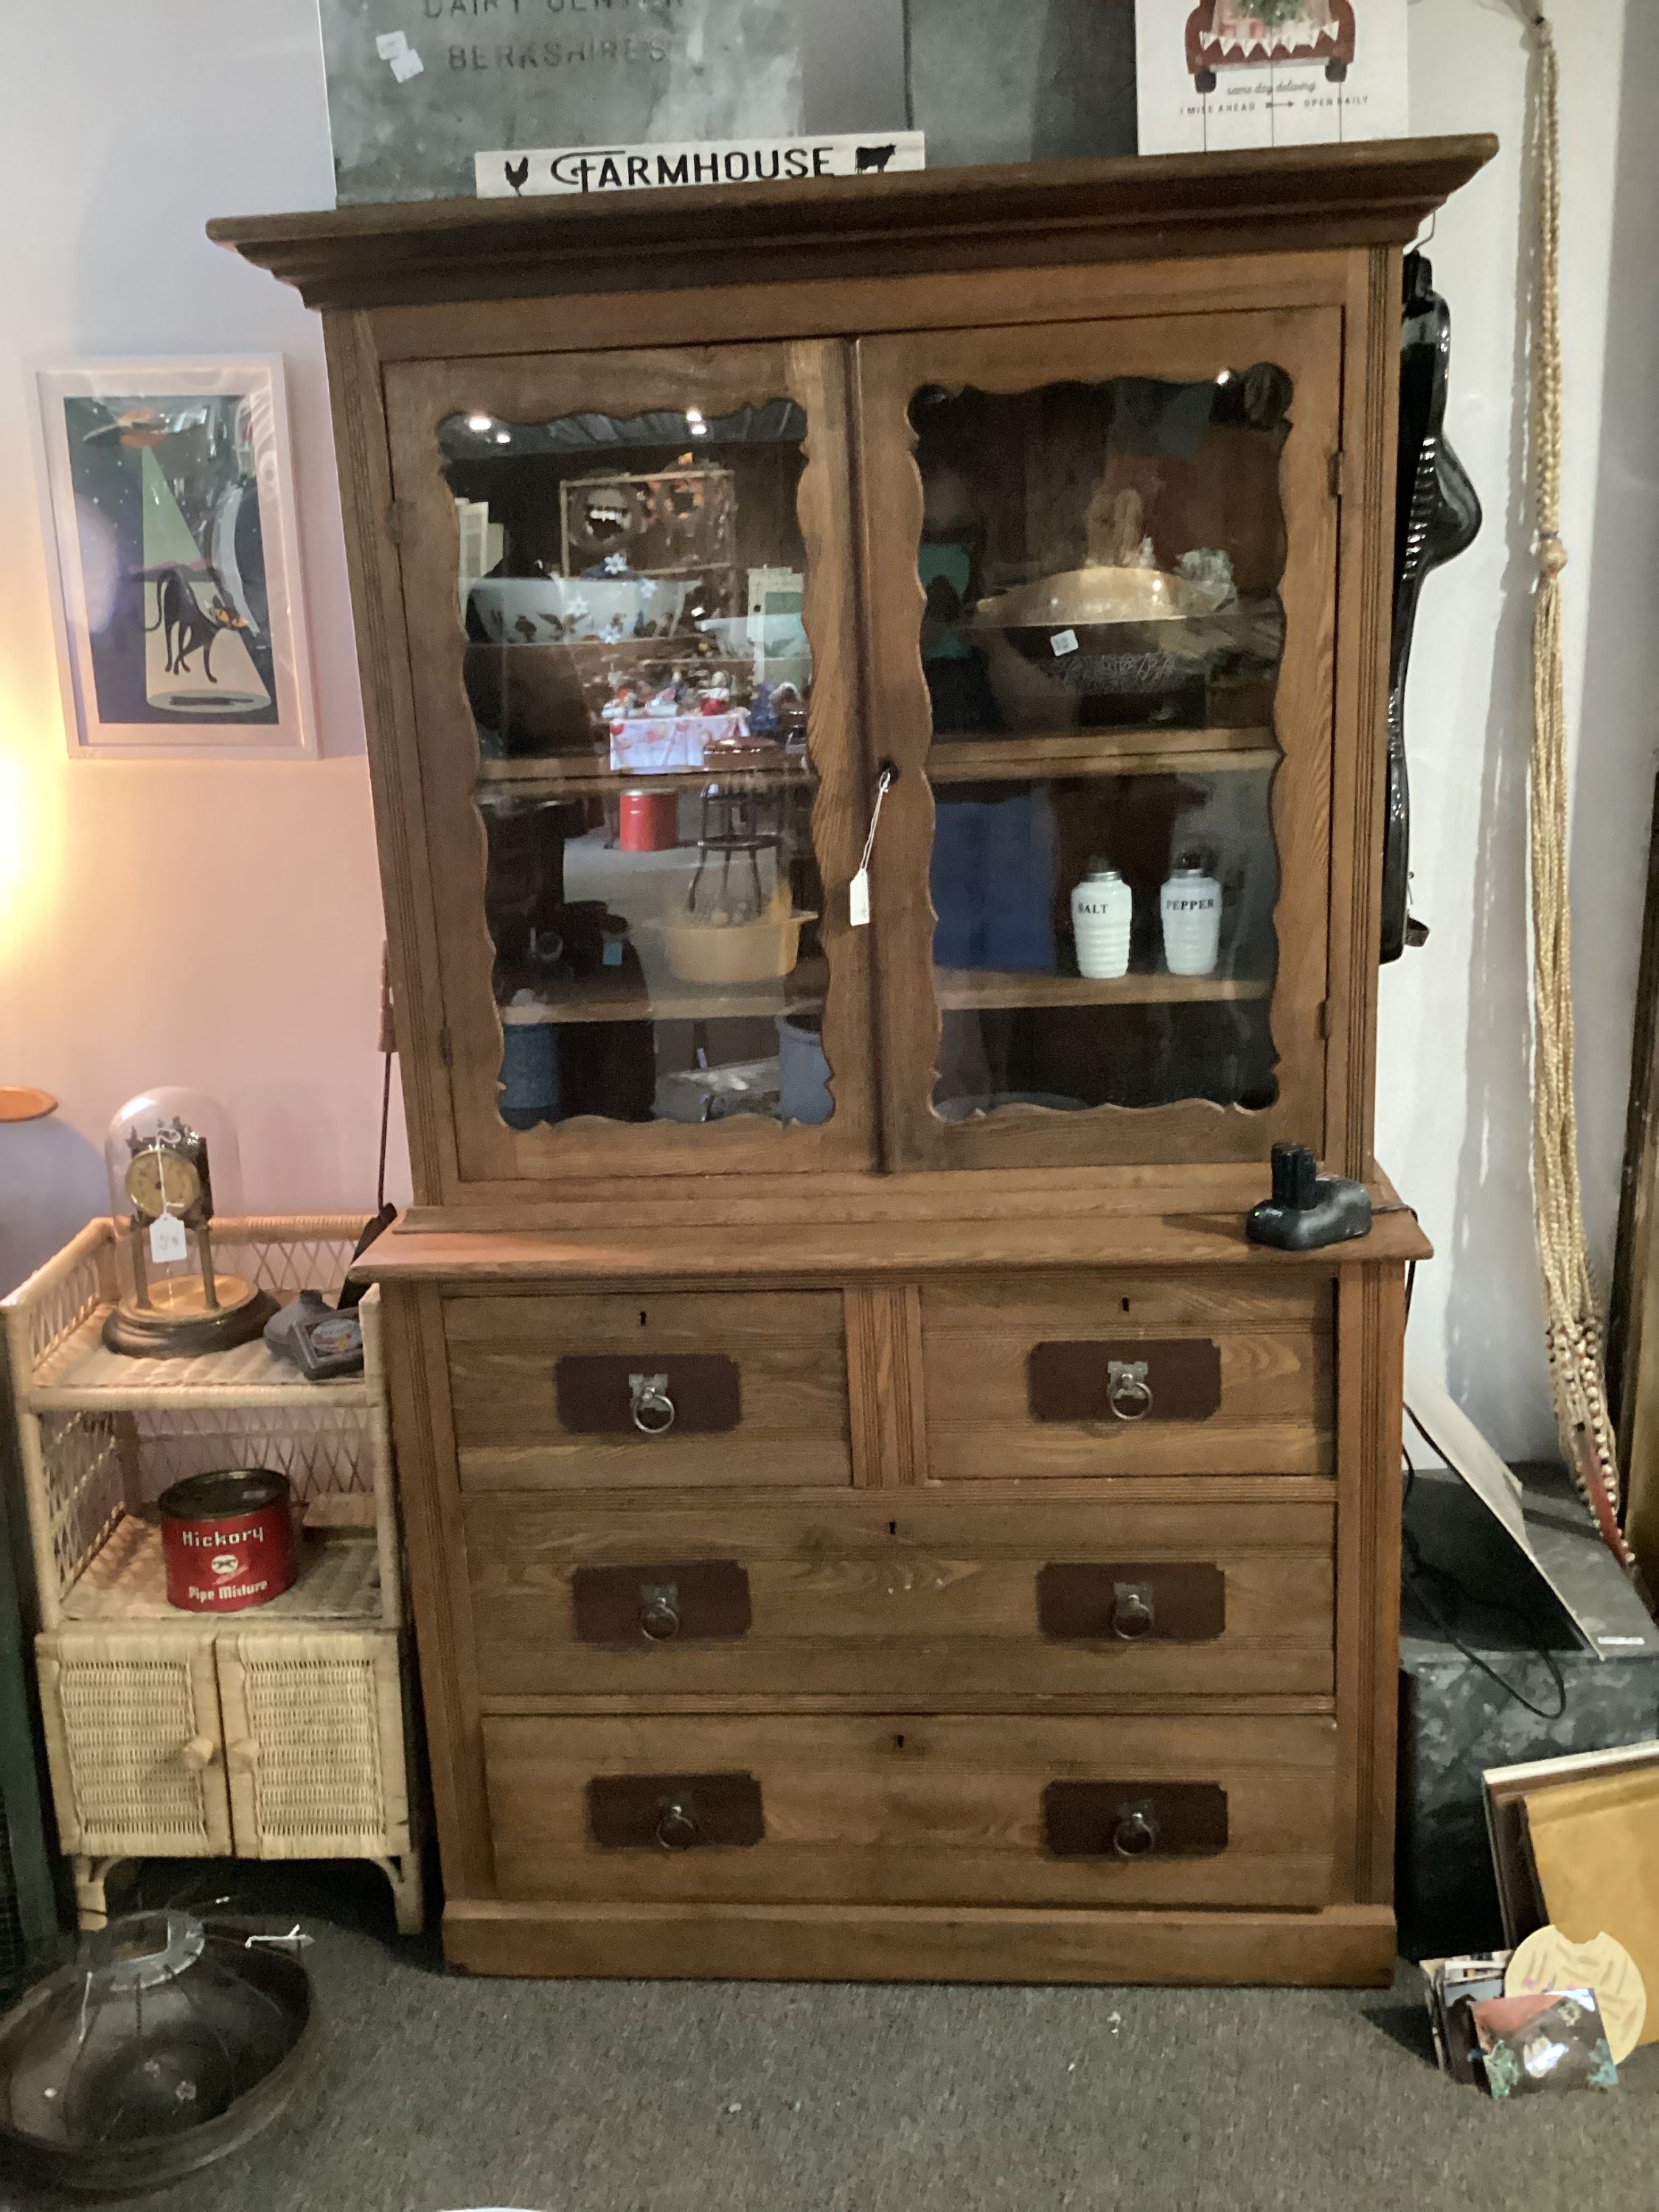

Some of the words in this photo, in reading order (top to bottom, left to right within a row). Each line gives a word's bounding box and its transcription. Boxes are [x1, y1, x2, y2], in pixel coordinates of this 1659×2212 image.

[448, 38, 665, 70] BERKSHIRES
[1227, 86, 1253, 95] same
[1254, 83, 1273, 96] day
[1276, 80, 1316, 94] delivery
[1187, 105, 1213, 114] MILE
[1217, 102, 1256, 113] AHEAD
[1304, 98, 1333, 108] OPEN
[1337, 95, 1368, 105] DAILY
[550, 147, 834, 192] FARMHOUSE
[1078, 902, 1108, 914] SALT
[1166, 898, 1214, 911] PEPPER
[182, 1526, 263, 1547] Hickory
[189, 1586, 215, 1604] Pipe
[218, 1580, 268, 1599] Mixture
